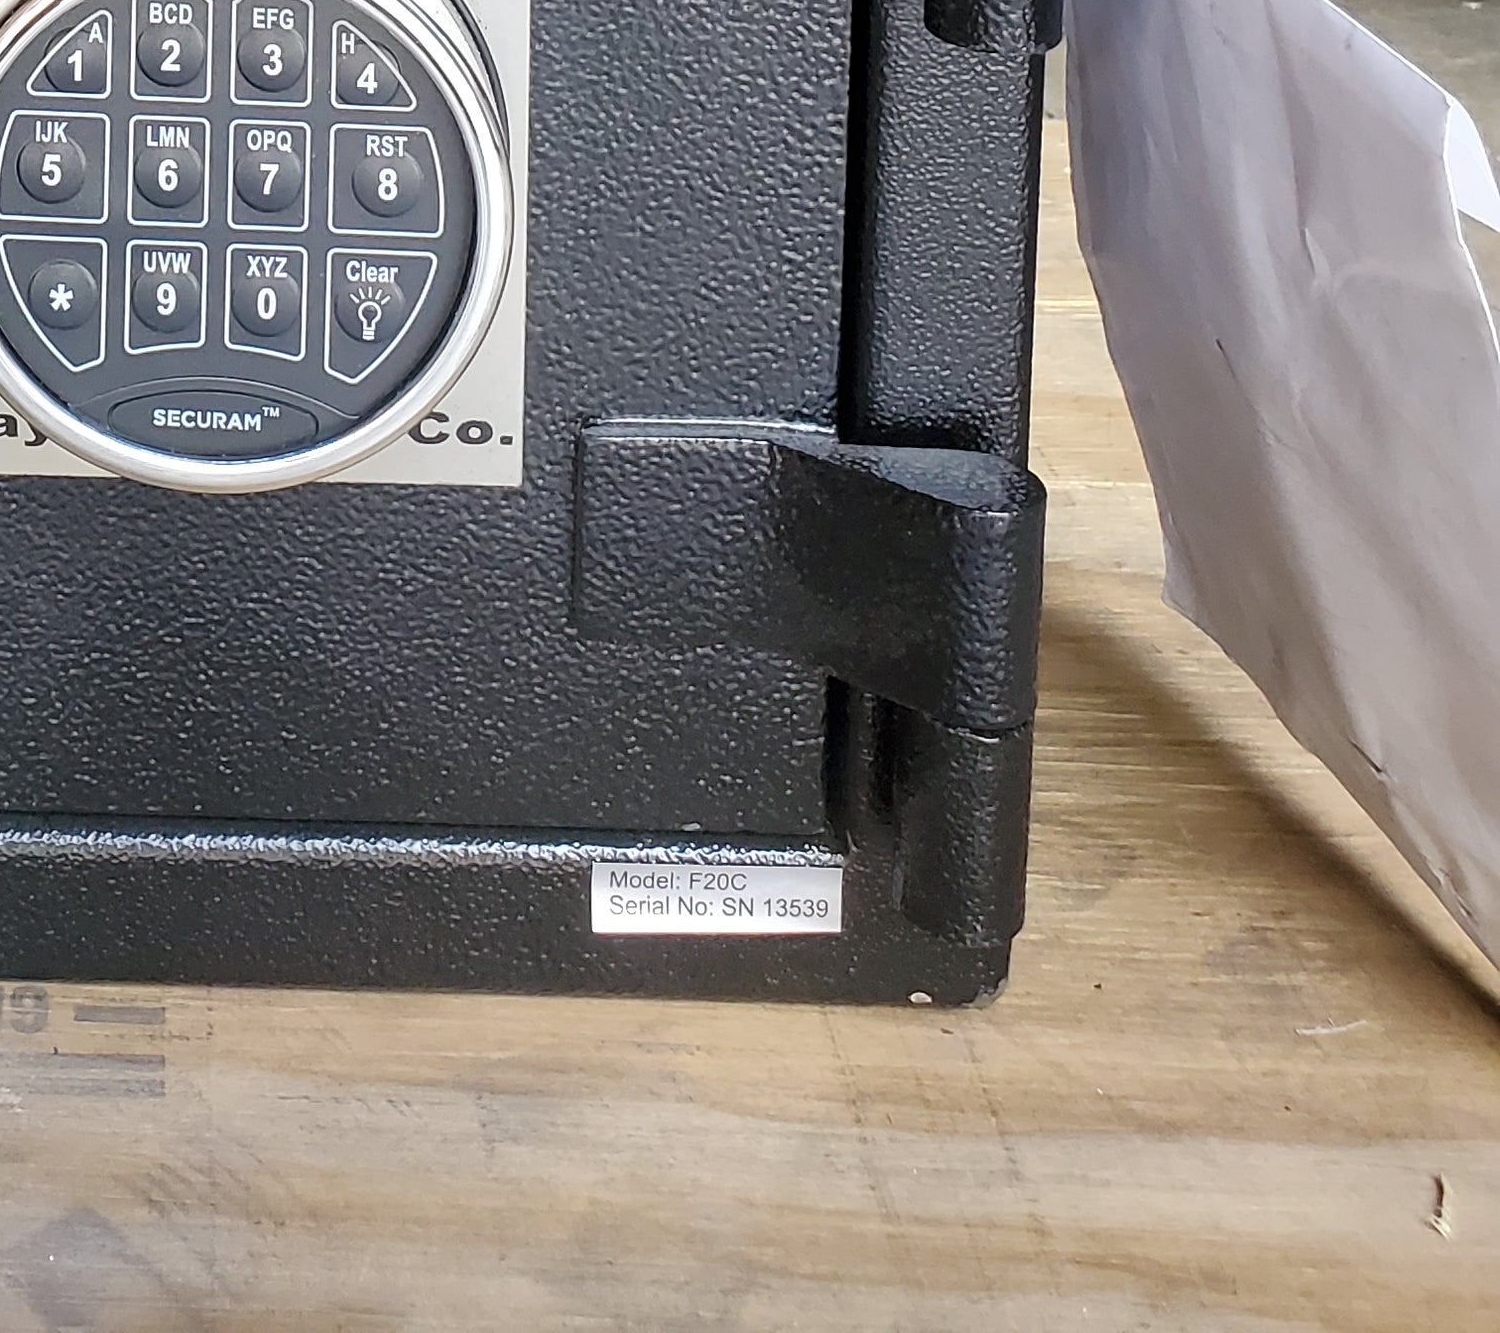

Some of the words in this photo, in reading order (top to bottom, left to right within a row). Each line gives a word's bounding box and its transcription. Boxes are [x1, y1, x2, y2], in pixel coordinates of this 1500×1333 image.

[149, 2, 193, 25] BCD
[252, 7, 295, 30] EFG
[88, 22, 104, 44] A
[341, 33, 355, 54] H
[67, 50, 83, 82] 1
[160, 39, 181, 72] 2
[262, 43, 283, 76] 3
[356, 62, 378, 94] 4
[35, 120, 68, 143] IJK
[146, 125, 190, 148] LMN
[246, 129, 293, 153] OPQ
[366, 134, 408, 158] RST
[41, 153, 62, 187] 5
[157, 158, 179, 192] 6
[259, 163, 280, 195] 7
[377, 168, 398, 201] 8
[143, 251, 192, 275] UVW
[246, 255, 289, 278] XYZ
[345, 260, 399, 283] Clear
[156, 283, 177, 316] 9
[256, 287, 278, 320] 0
[408, 411, 513, 446] Co.
[609, 870, 680, 890] Model:
[689, 872, 748, 891] F20C
[609, 894, 670, 916] Serial
[677, 896, 713, 917] No:
[721, 897, 755, 918] SN
[763, 898, 829, 919] 13539
